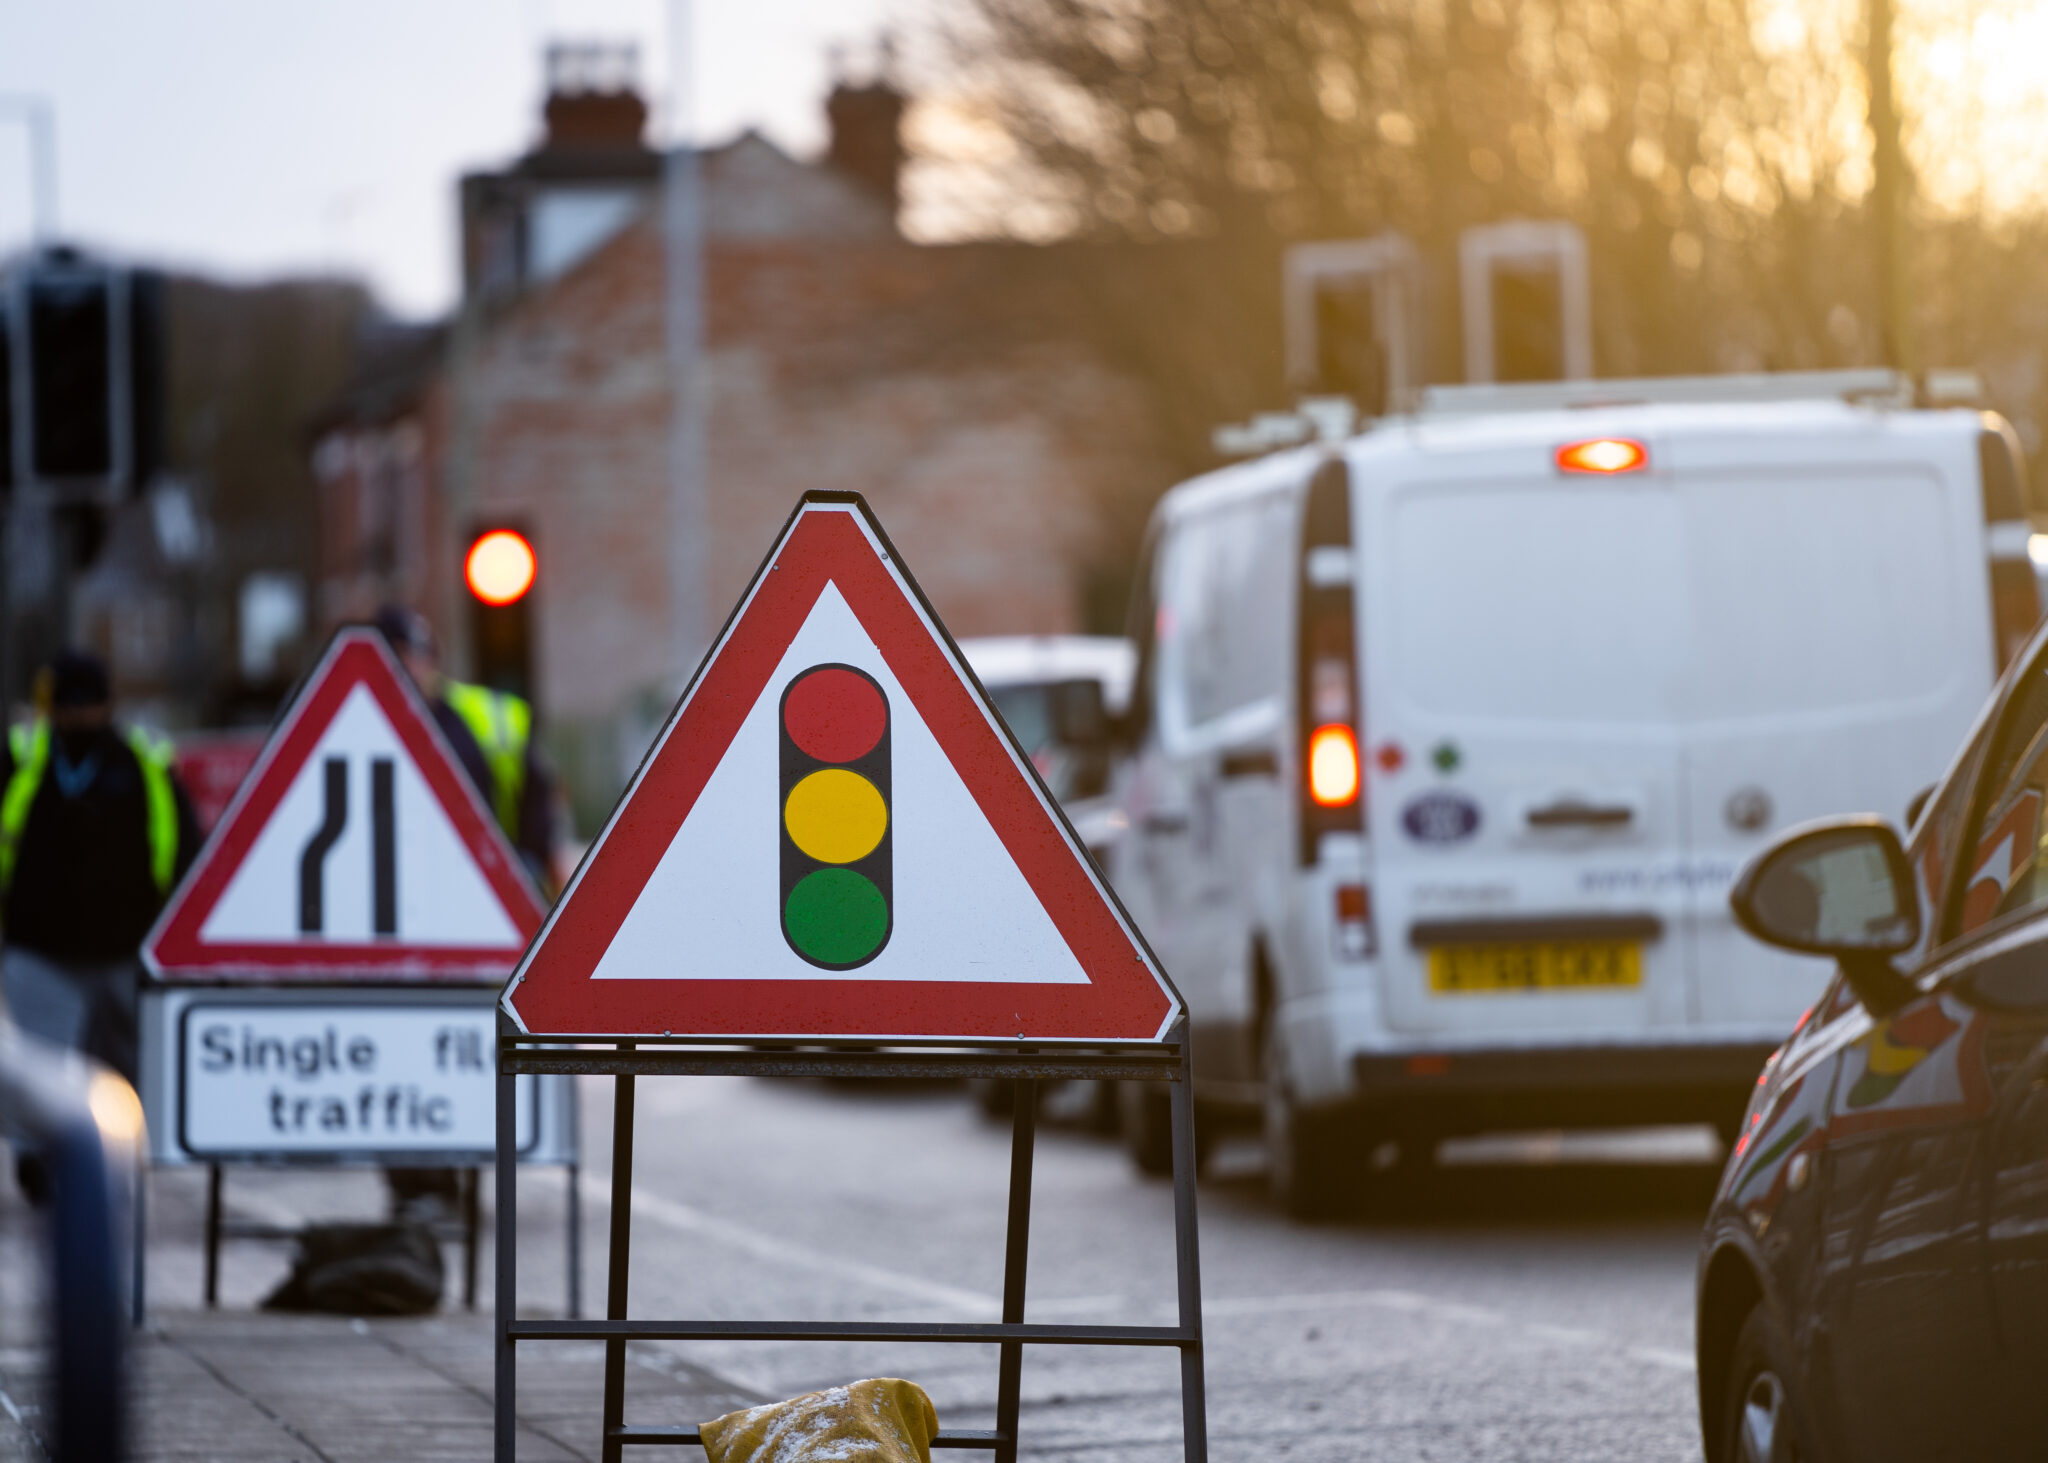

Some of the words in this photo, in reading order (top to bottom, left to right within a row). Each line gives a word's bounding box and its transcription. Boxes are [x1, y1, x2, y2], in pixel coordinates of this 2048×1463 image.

[202, 1026, 377, 1079] Single
[434, 1026, 497, 1072] fil
[269, 1086, 454, 1132] traffic
